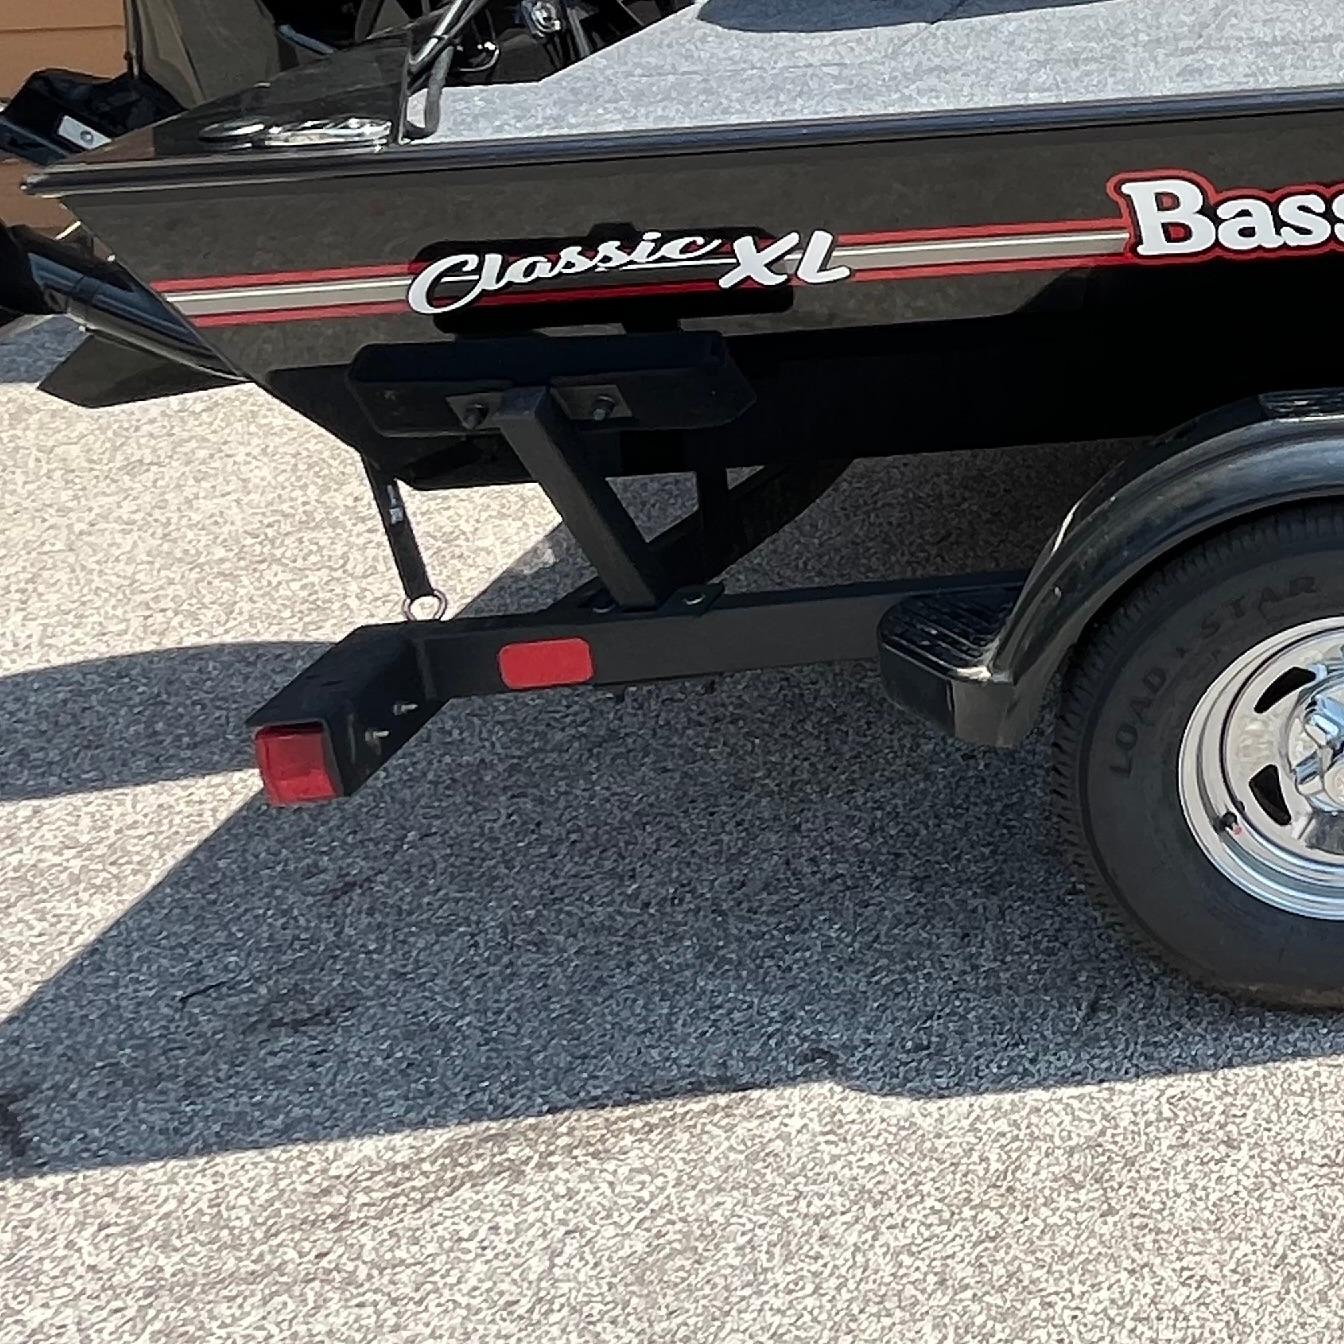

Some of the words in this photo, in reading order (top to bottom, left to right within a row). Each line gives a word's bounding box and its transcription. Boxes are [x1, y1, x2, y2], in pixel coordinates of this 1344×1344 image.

[407, 230, 717, 315] Classic
[718, 229, 851, 289] XL
[1109, 666, 1167, 779] LOAD
[1200, 576, 1319, 640] STAR
